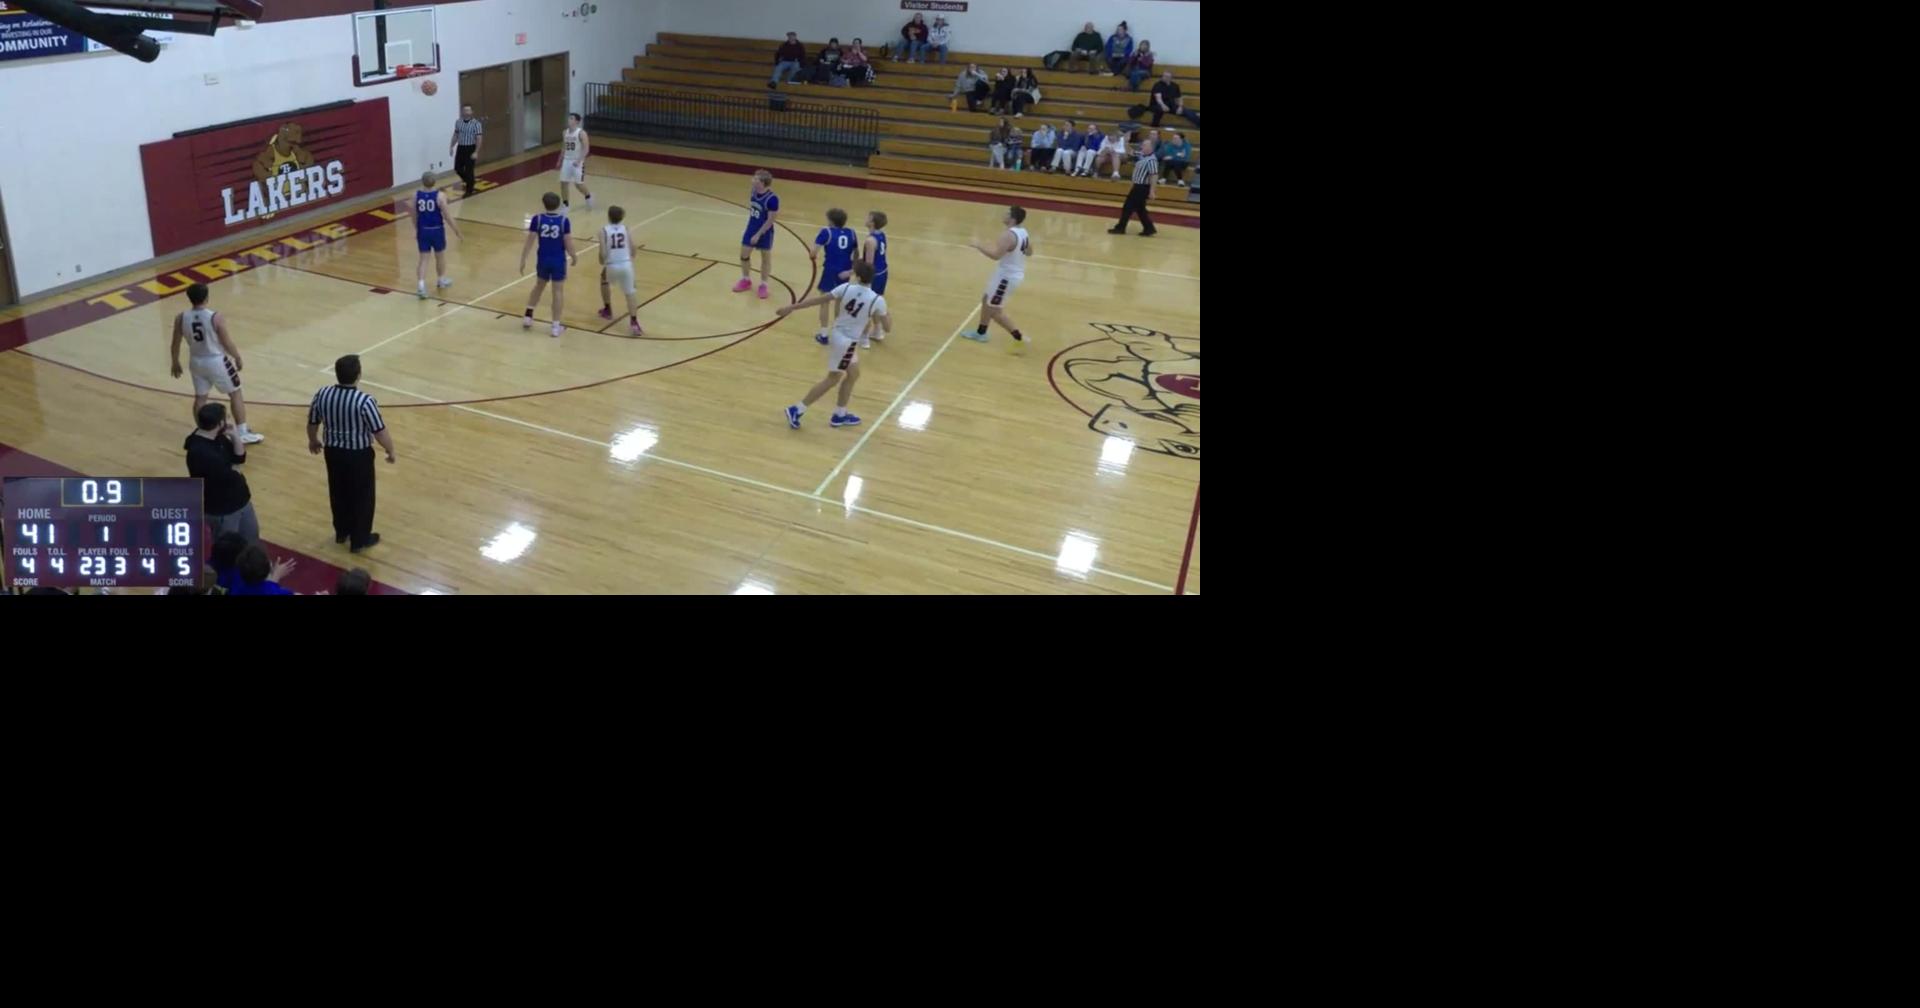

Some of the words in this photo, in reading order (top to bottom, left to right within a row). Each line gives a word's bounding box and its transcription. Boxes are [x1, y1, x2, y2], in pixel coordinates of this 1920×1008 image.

[930, 2, 964, 10] Students
[221, 160, 345, 225] LAKERS
[417, 199, 436, 212] 30
[540, 224, 560, 238] 23
[610, 233, 625, 249] 12
[838, 235, 849, 250] 0
[88, 222, 357, 310] TURTLE
[845, 298, 864, 318] 41
[191, 322, 204, 342] 5
